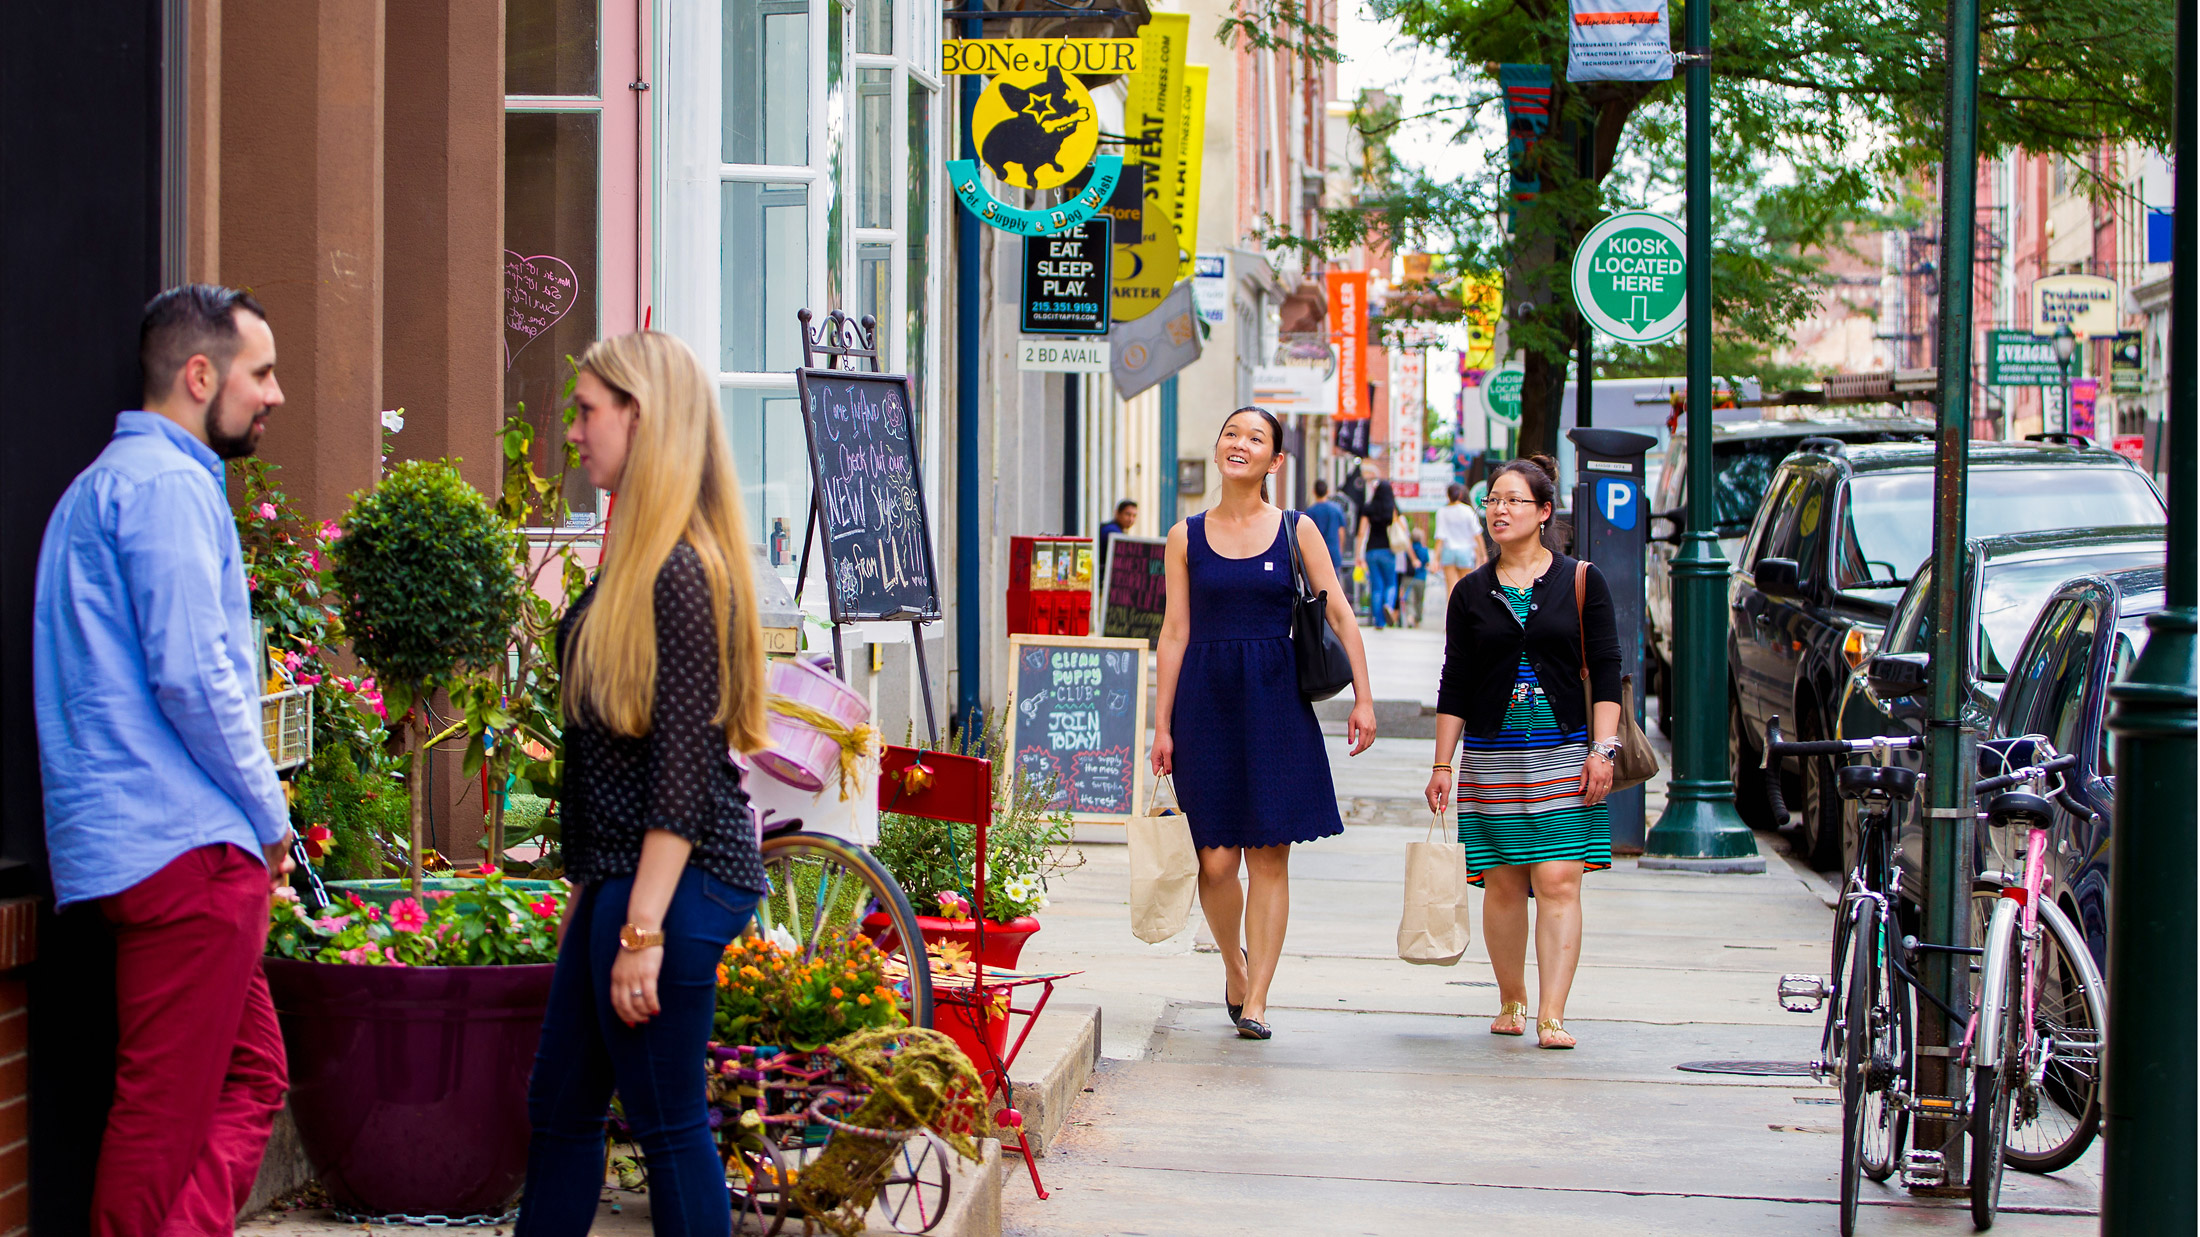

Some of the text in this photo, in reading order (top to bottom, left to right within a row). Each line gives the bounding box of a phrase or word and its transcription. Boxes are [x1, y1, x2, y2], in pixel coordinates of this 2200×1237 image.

[1629, 14, 1637, 27] by
[1034, 42, 1137, 72] JOUR
[1156, 35, 1171, 113] FITNESS.COM
[958, 174, 1113, 232] Pet Supply & Dog Wash
[1050, 241, 1084, 258] EAT.
[1608, 237, 1669, 255] KIOSK
[1037, 260, 1096, 278] SLEEP.
[1594, 256, 1683, 275] LOCATED
[1043, 280, 1089, 297] PLAY.
[1612, 275, 1664, 292] HERE
[2042, 288, 2111, 301] Prudential
[1032, 301, 1098, 313] 215.351.9193
[1340, 282, 1356, 335] ADLER
[2042, 300, 2089, 314] Savings
[1033, 313, 1097, 321] OLDCITYAPTS.COM
[2042, 310, 2074, 323] Bank
[1025, 348, 1102, 364] 2 BD AVAIL
[1342, 336, 1357, 414] JONATHAN
[823, 385, 849, 441] Come
[839, 443, 869, 484] Check
[825, 475, 867, 528] NEW
[1607, 483, 1631, 520] P
[1051, 652, 1100, 669] CLEAN
[1052, 667, 1102, 687] PUPPY
[1057, 685, 1093, 702] CLUB
[1048, 710, 1100, 731] JOIN
[1047, 731, 1101, 751] TODAY!
[1040, 757, 1049, 770] 5
[1085, 763, 1120, 775] the mess
